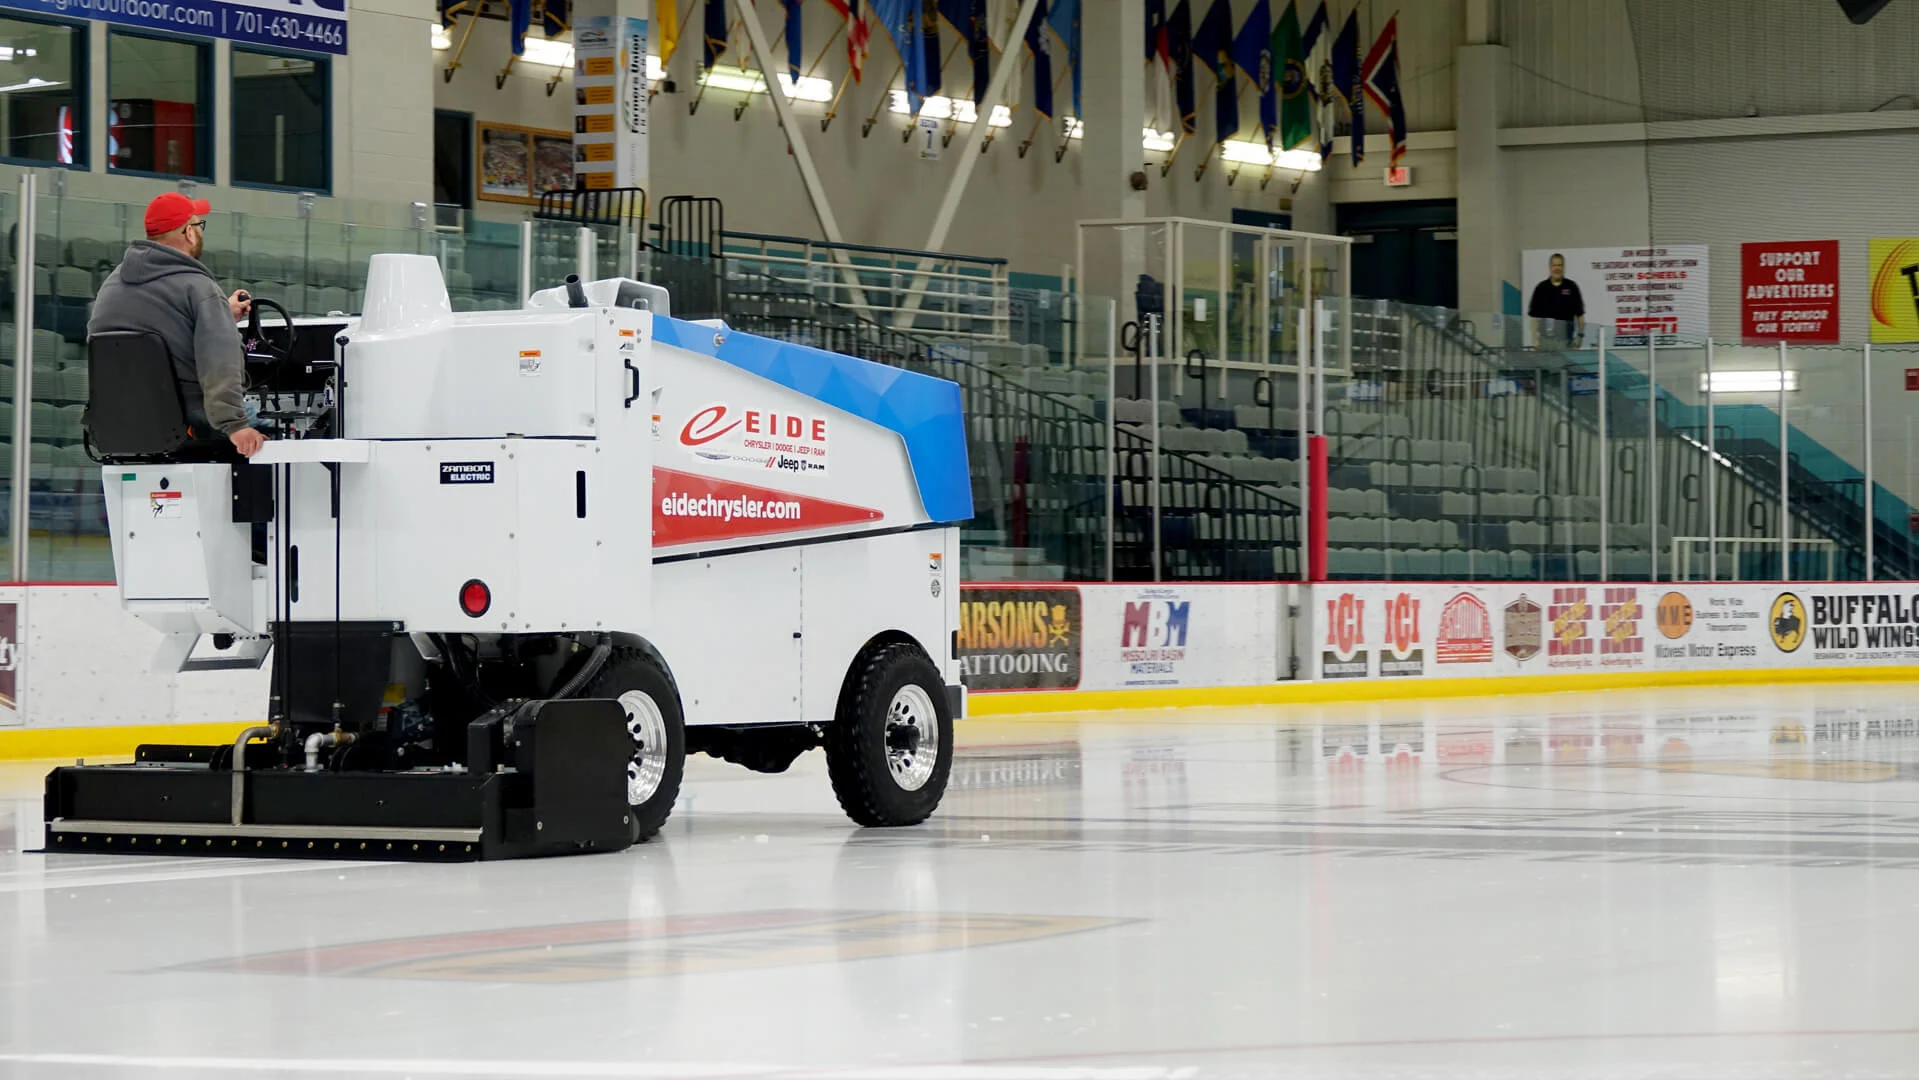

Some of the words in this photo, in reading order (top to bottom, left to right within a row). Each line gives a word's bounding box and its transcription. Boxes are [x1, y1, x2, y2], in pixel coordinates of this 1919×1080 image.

[41, 0, 214, 27] gaoutdoor.com
[235, 10, 343, 46] 701-630-4466
[631, 34, 640, 73] Union
[631, 76, 640, 134] Farmers
[1759, 251, 1820, 267] SUPPORT
[1637, 271, 1688, 280] SCHEELS
[1775, 268, 1804, 282] OUR
[1746, 283, 1835, 300] ADVERTISERS
[1752, 310, 1778, 321] THEY
[1780, 309, 1829, 321] SPONSOR
[1755, 323, 1778, 334] OUR
[1781, 322, 1821, 333] YOUTH!
[746, 410, 826, 442] EIDE
[743, 439, 772, 451] CHRYSLER
[775, 443, 793, 453] DODGE
[797, 446, 810, 455] JEEP
[813, 448, 826, 457] RAM
[777, 454, 799, 473] Jeep
[450, 473, 491, 481] ELECTRIC
[661, 492, 801, 522] eidechrysler.com
[1121, 601, 1191, 648] MBM
[1811, 626, 1859, 649] WILD
[1121, 650, 1159, 662] MISSOURI
[1161, 650, 1185, 661] BASIN
[1717, 642, 1757, 660] Express
[1130, 662, 1174, 674] MATERIALS
